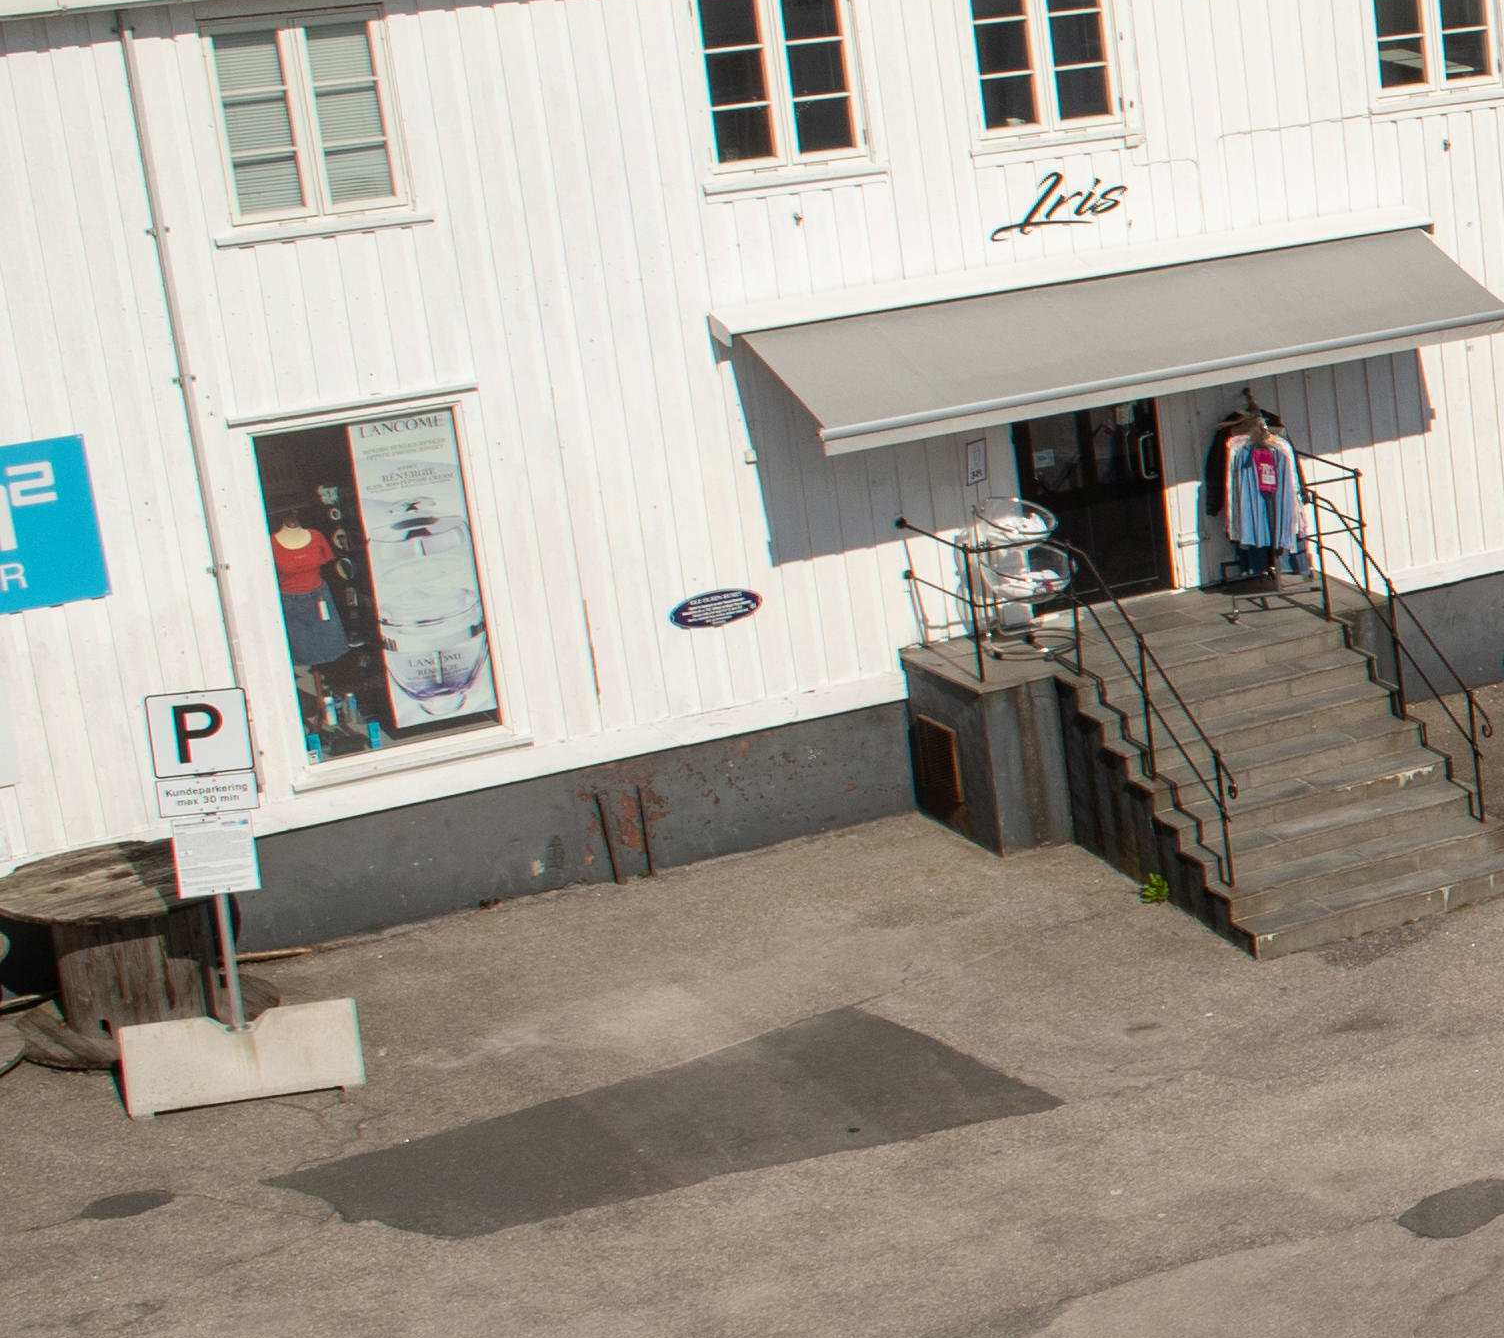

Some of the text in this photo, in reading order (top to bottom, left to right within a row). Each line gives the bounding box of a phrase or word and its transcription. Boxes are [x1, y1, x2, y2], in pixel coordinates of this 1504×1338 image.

[990, 171, 1128, 241] Iris
[172, 703, 223, 764] P
[165, 782, 248, 798] Kundeparkering
[177, 794, 240, 807] max 30 min
